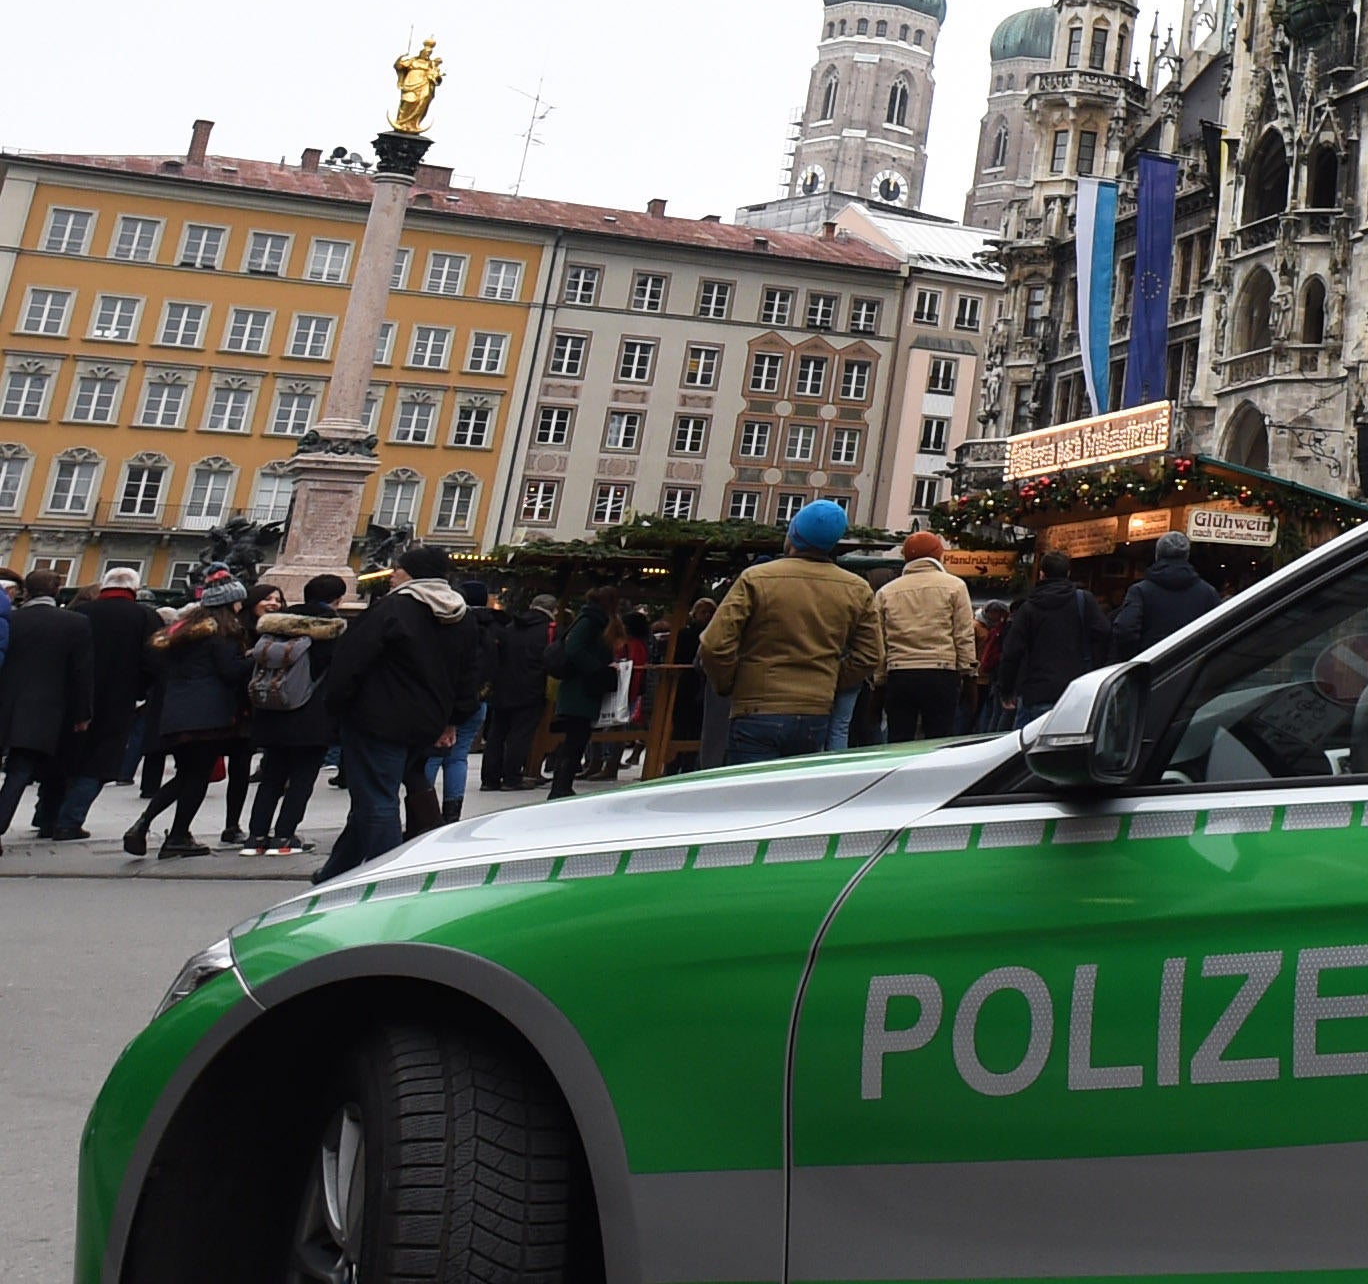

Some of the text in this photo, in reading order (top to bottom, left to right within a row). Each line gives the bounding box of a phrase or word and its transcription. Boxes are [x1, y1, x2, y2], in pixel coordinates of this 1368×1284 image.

[1194, 512, 1273, 532] Glühwein
[1193, 528, 1212, 538] nach
[943, 554, 1011, 567] Pfandrückgab
